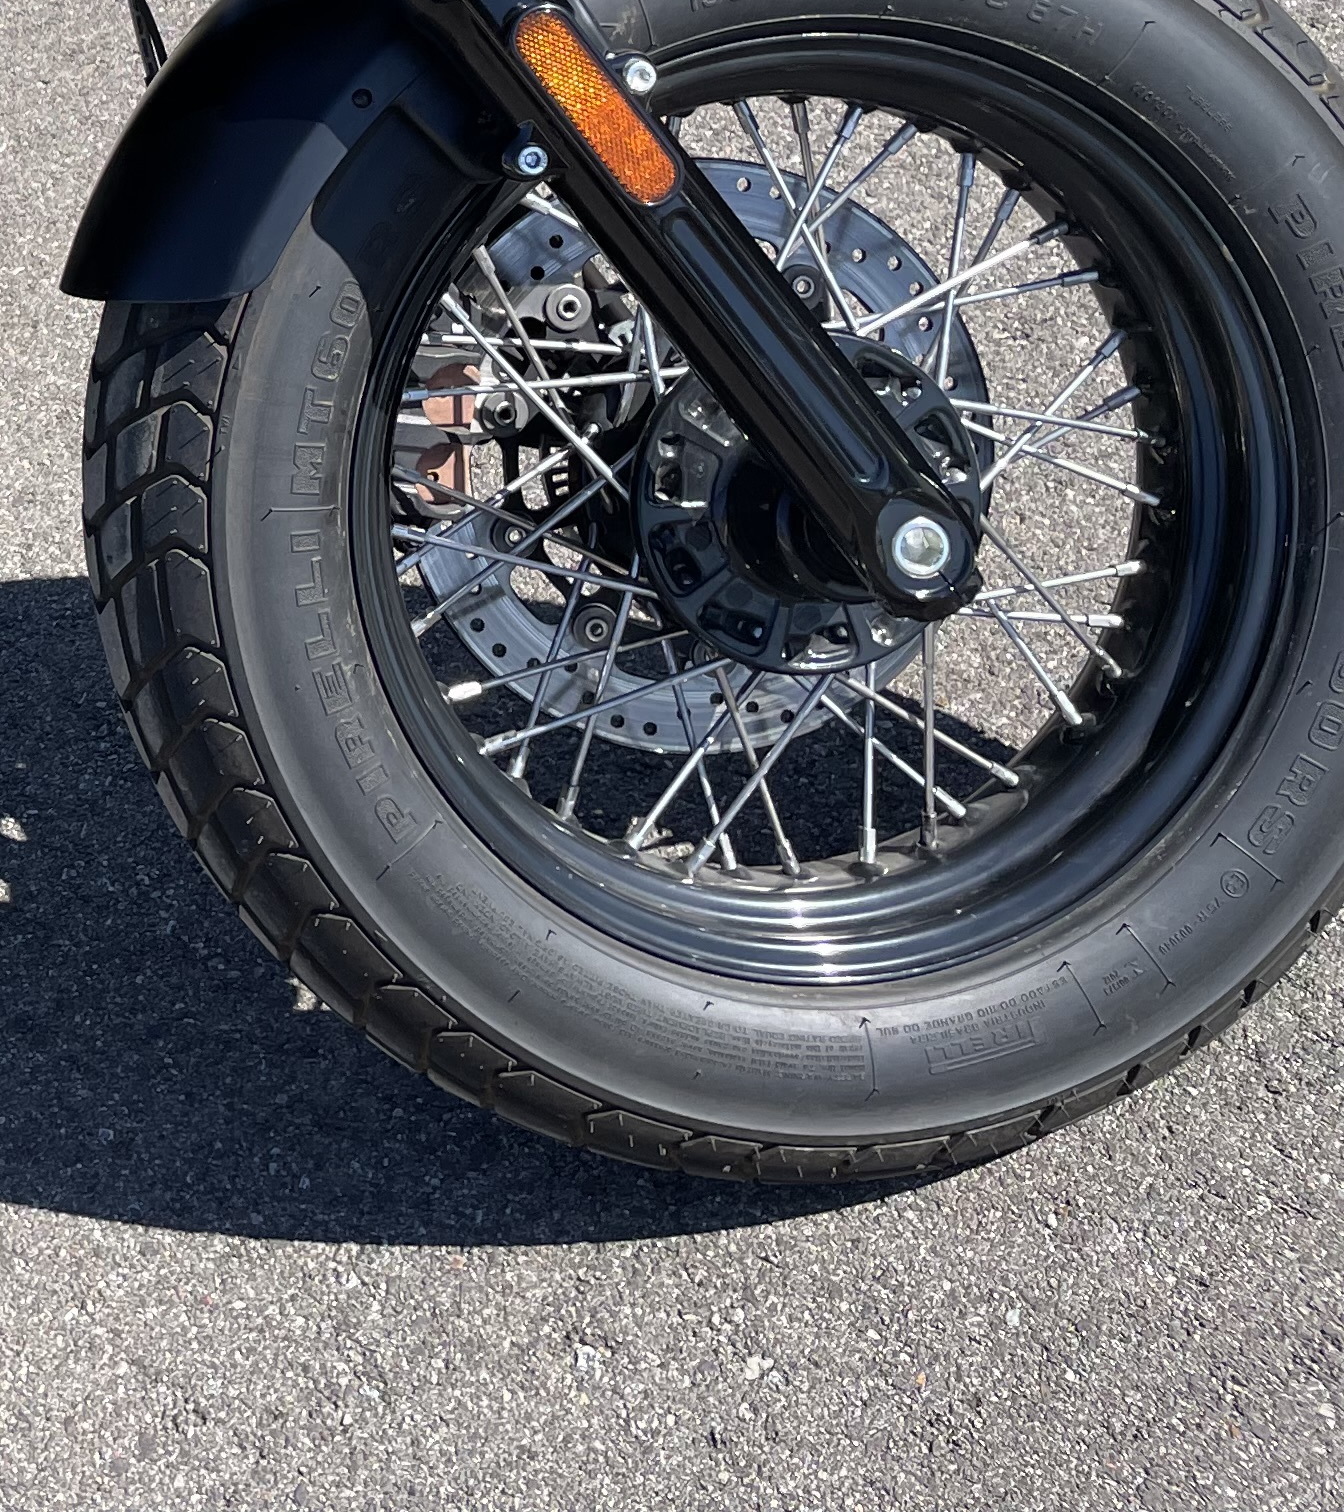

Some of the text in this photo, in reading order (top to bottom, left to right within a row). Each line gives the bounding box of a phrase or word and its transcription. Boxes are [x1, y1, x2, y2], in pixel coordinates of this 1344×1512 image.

[289, 529, 419, 845] PIRELLI
[1247, 752, 1330, 855] RS
[926, 1018, 1050, 1074] PIRELLI
